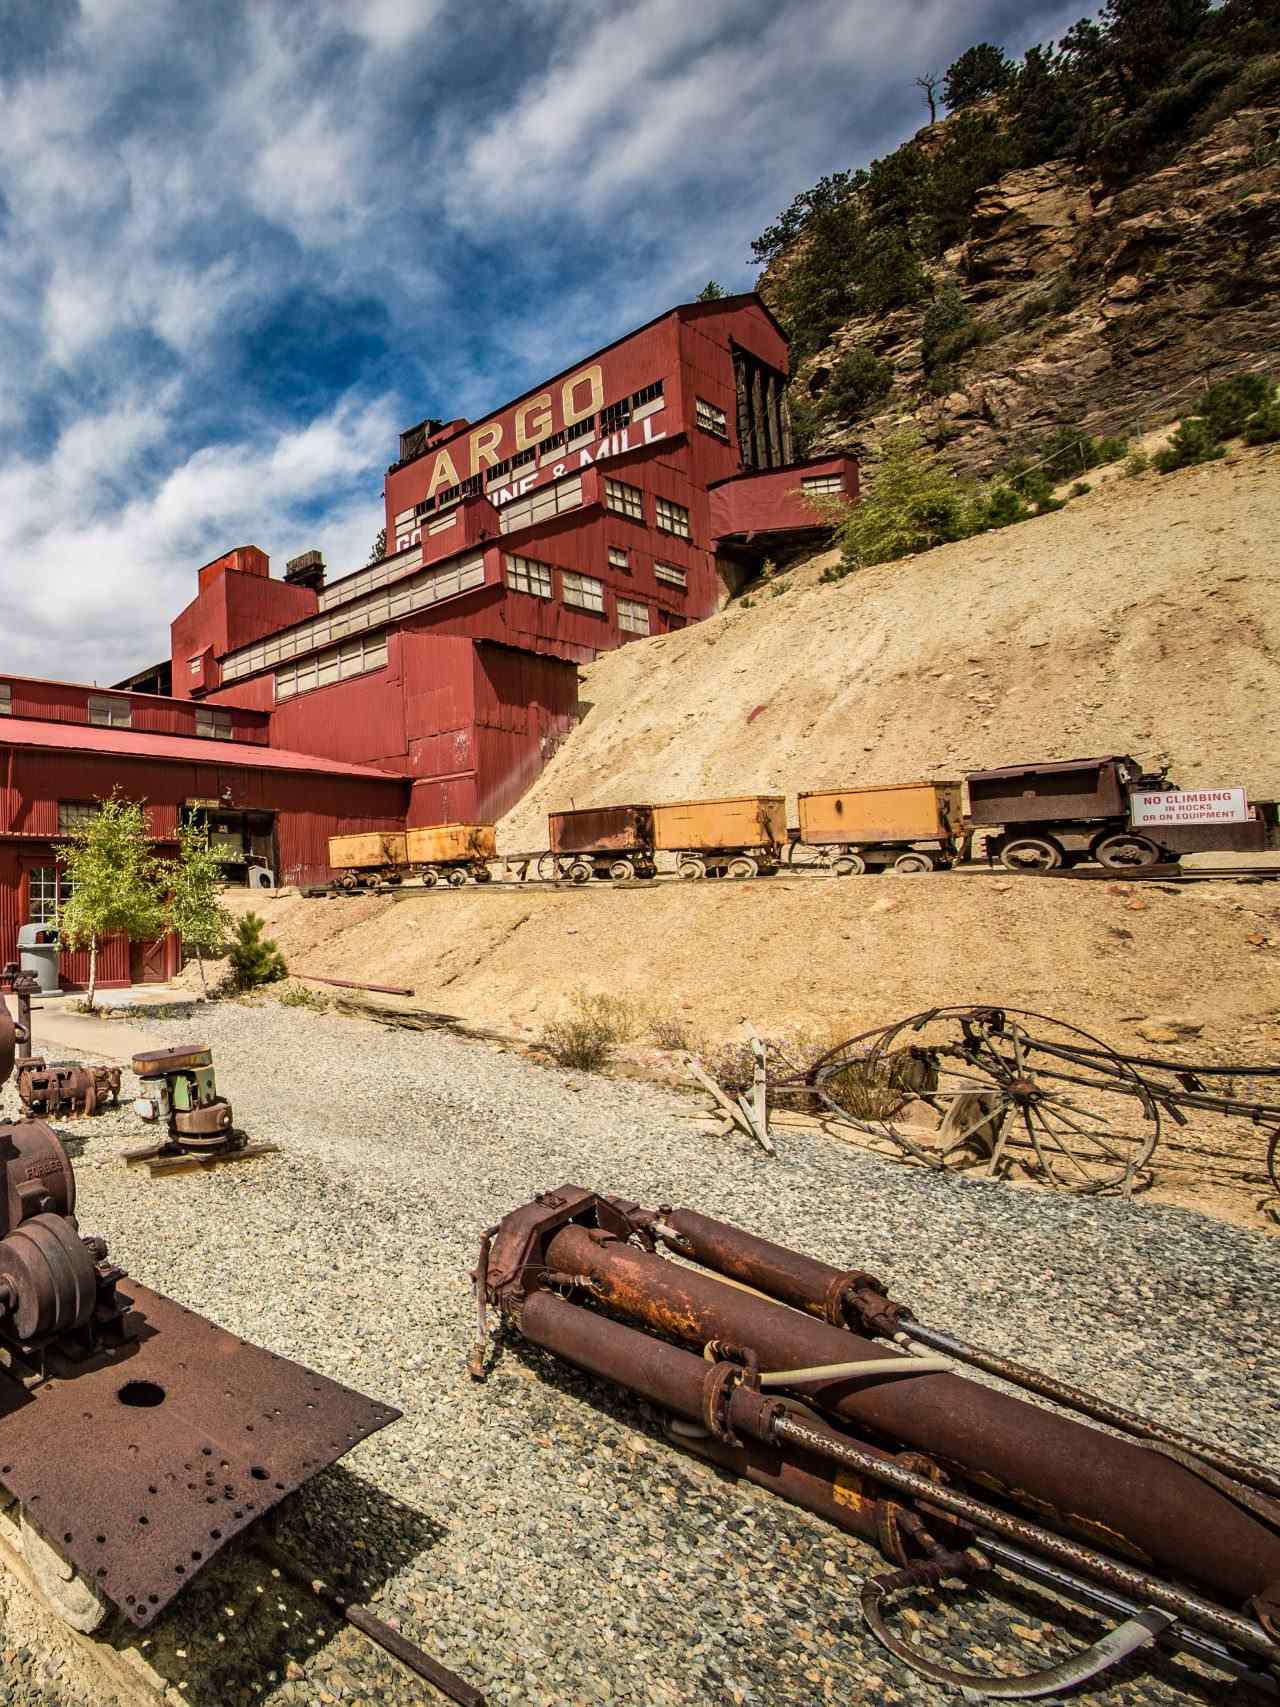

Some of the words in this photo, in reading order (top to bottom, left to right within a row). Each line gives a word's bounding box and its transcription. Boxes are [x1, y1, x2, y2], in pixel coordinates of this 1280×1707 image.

[425, 364, 604, 499] ARGO
[486, 472, 540, 507] INE
[553, 463, 568, 480] &
[580, 417, 667, 467] MILL
[1143, 796, 1161, 805] NO
[1166, 792, 1232, 804] CLIMBING
[1178, 803, 1213, 811] ROCKS
[1143, 814, 1156, 822] OR
[1176, 811, 1235, 819] EQUIPMENT
